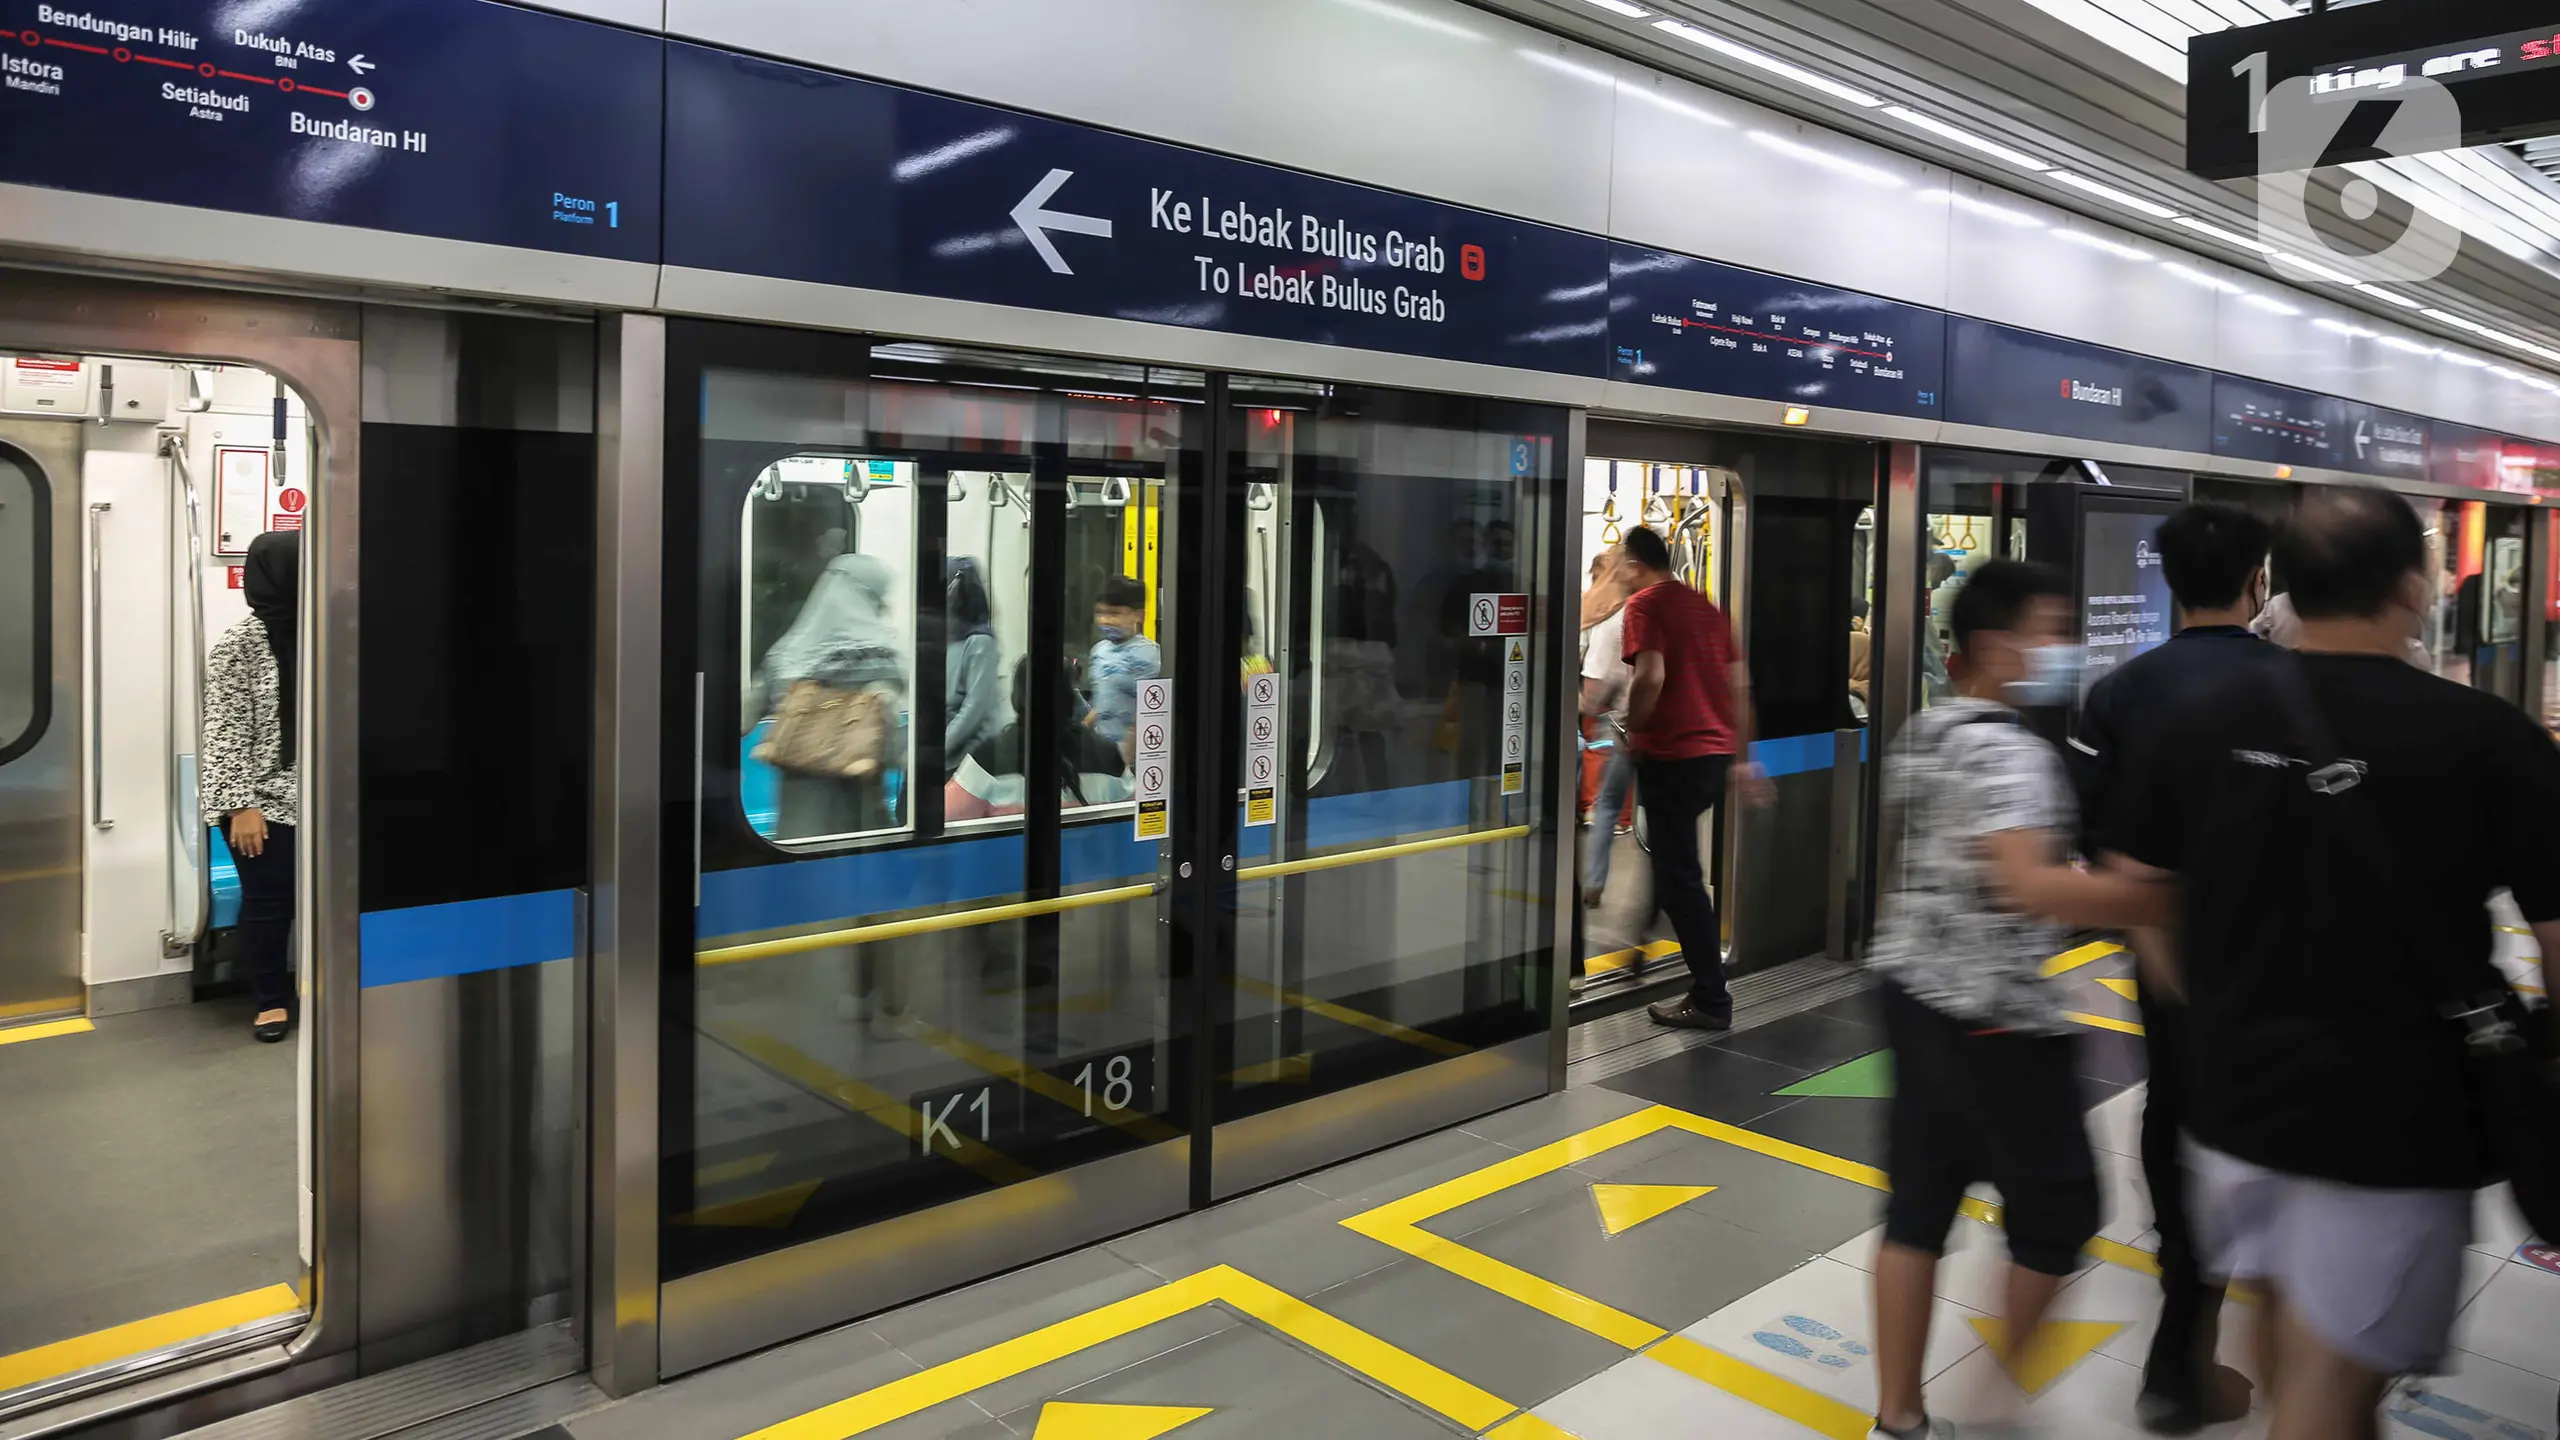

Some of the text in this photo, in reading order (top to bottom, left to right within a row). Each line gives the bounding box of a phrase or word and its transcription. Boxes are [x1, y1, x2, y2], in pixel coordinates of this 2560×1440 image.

[38, 4, 199, 50] Bendungan Hilir
[235, 29, 336, 63] Dukuh Atas
[275, 55, 297, 69] BNI
[2, 53, 63, 80] Istora
[2310, 63, 2407, 95] ting
[5, 75, 60, 95] Mandiri
[162, 82, 250, 112] Setiabudi
[2231, 51, 2268, 133] 1
[189, 106, 223, 121] Astra
[290, 111, 427, 153] Bundaran HI
[553, 192, 618, 228] Peron 1
[553, 210, 594, 225] Platform
[1151, 188, 1445, 274] Ke Lebak Bulus Grab
[1194, 255, 1445, 323] To Lebak Bulus Grab
[1635, 349, 1642, 365] 1
[2072, 379, 2111, 405] Bundaran
[1515, 443, 1528, 472] 3
[1073, 1055, 1133, 1117] 18
[922, 1087, 990, 1157] K1
